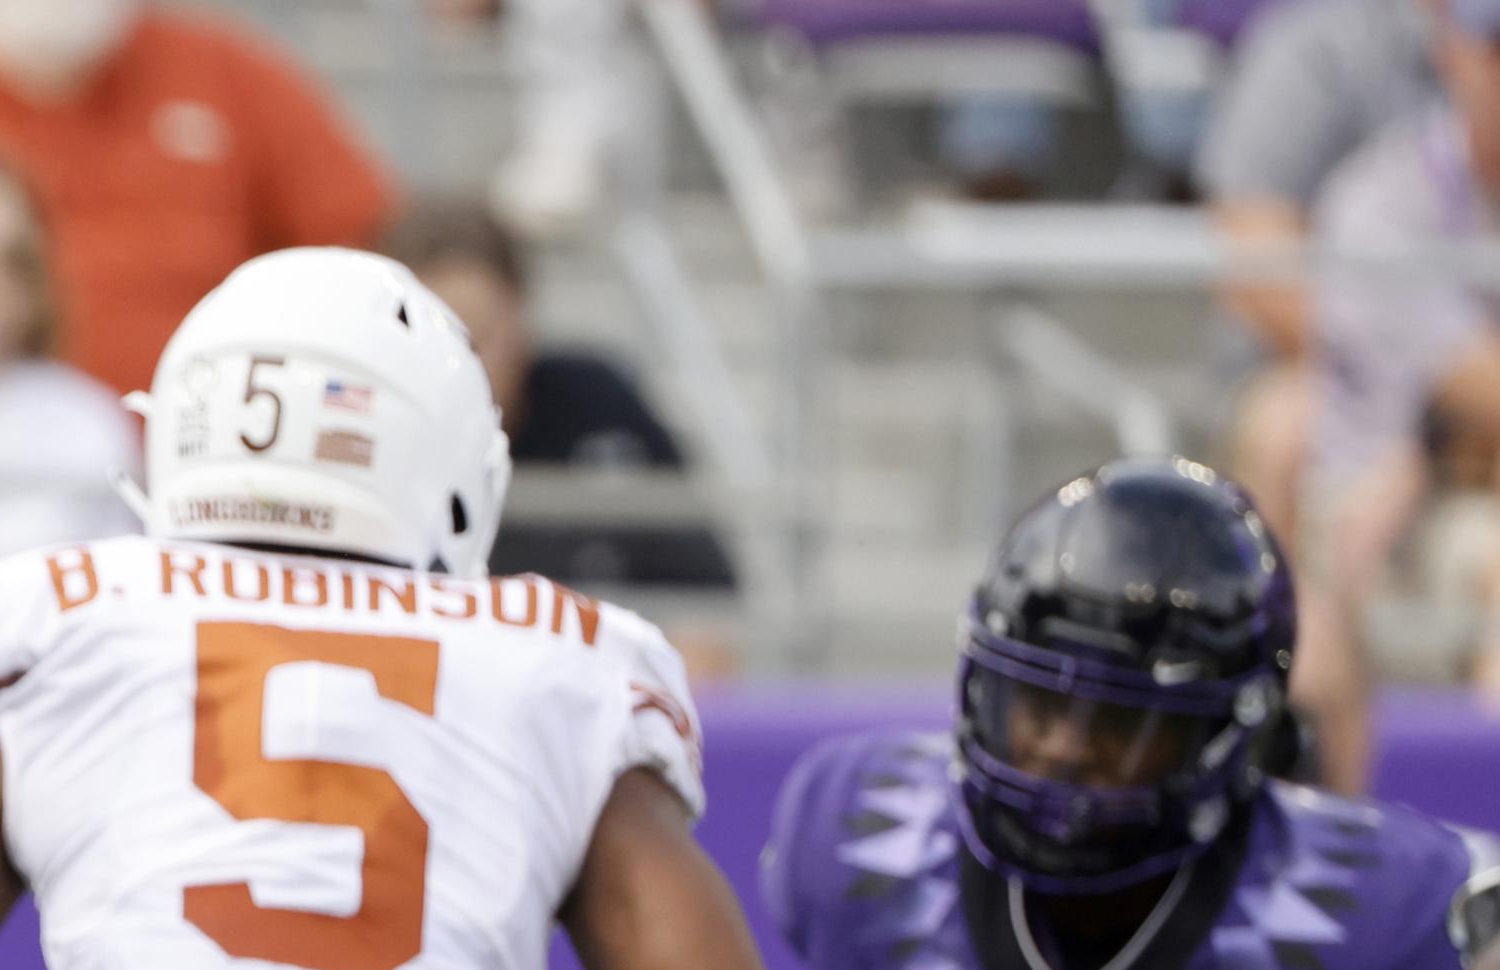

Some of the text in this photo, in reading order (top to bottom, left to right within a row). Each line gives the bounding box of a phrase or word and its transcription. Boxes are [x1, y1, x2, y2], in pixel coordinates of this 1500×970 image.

[239, 356, 285, 453] 5
[46, 546, 600, 646] B. ROBINSON
